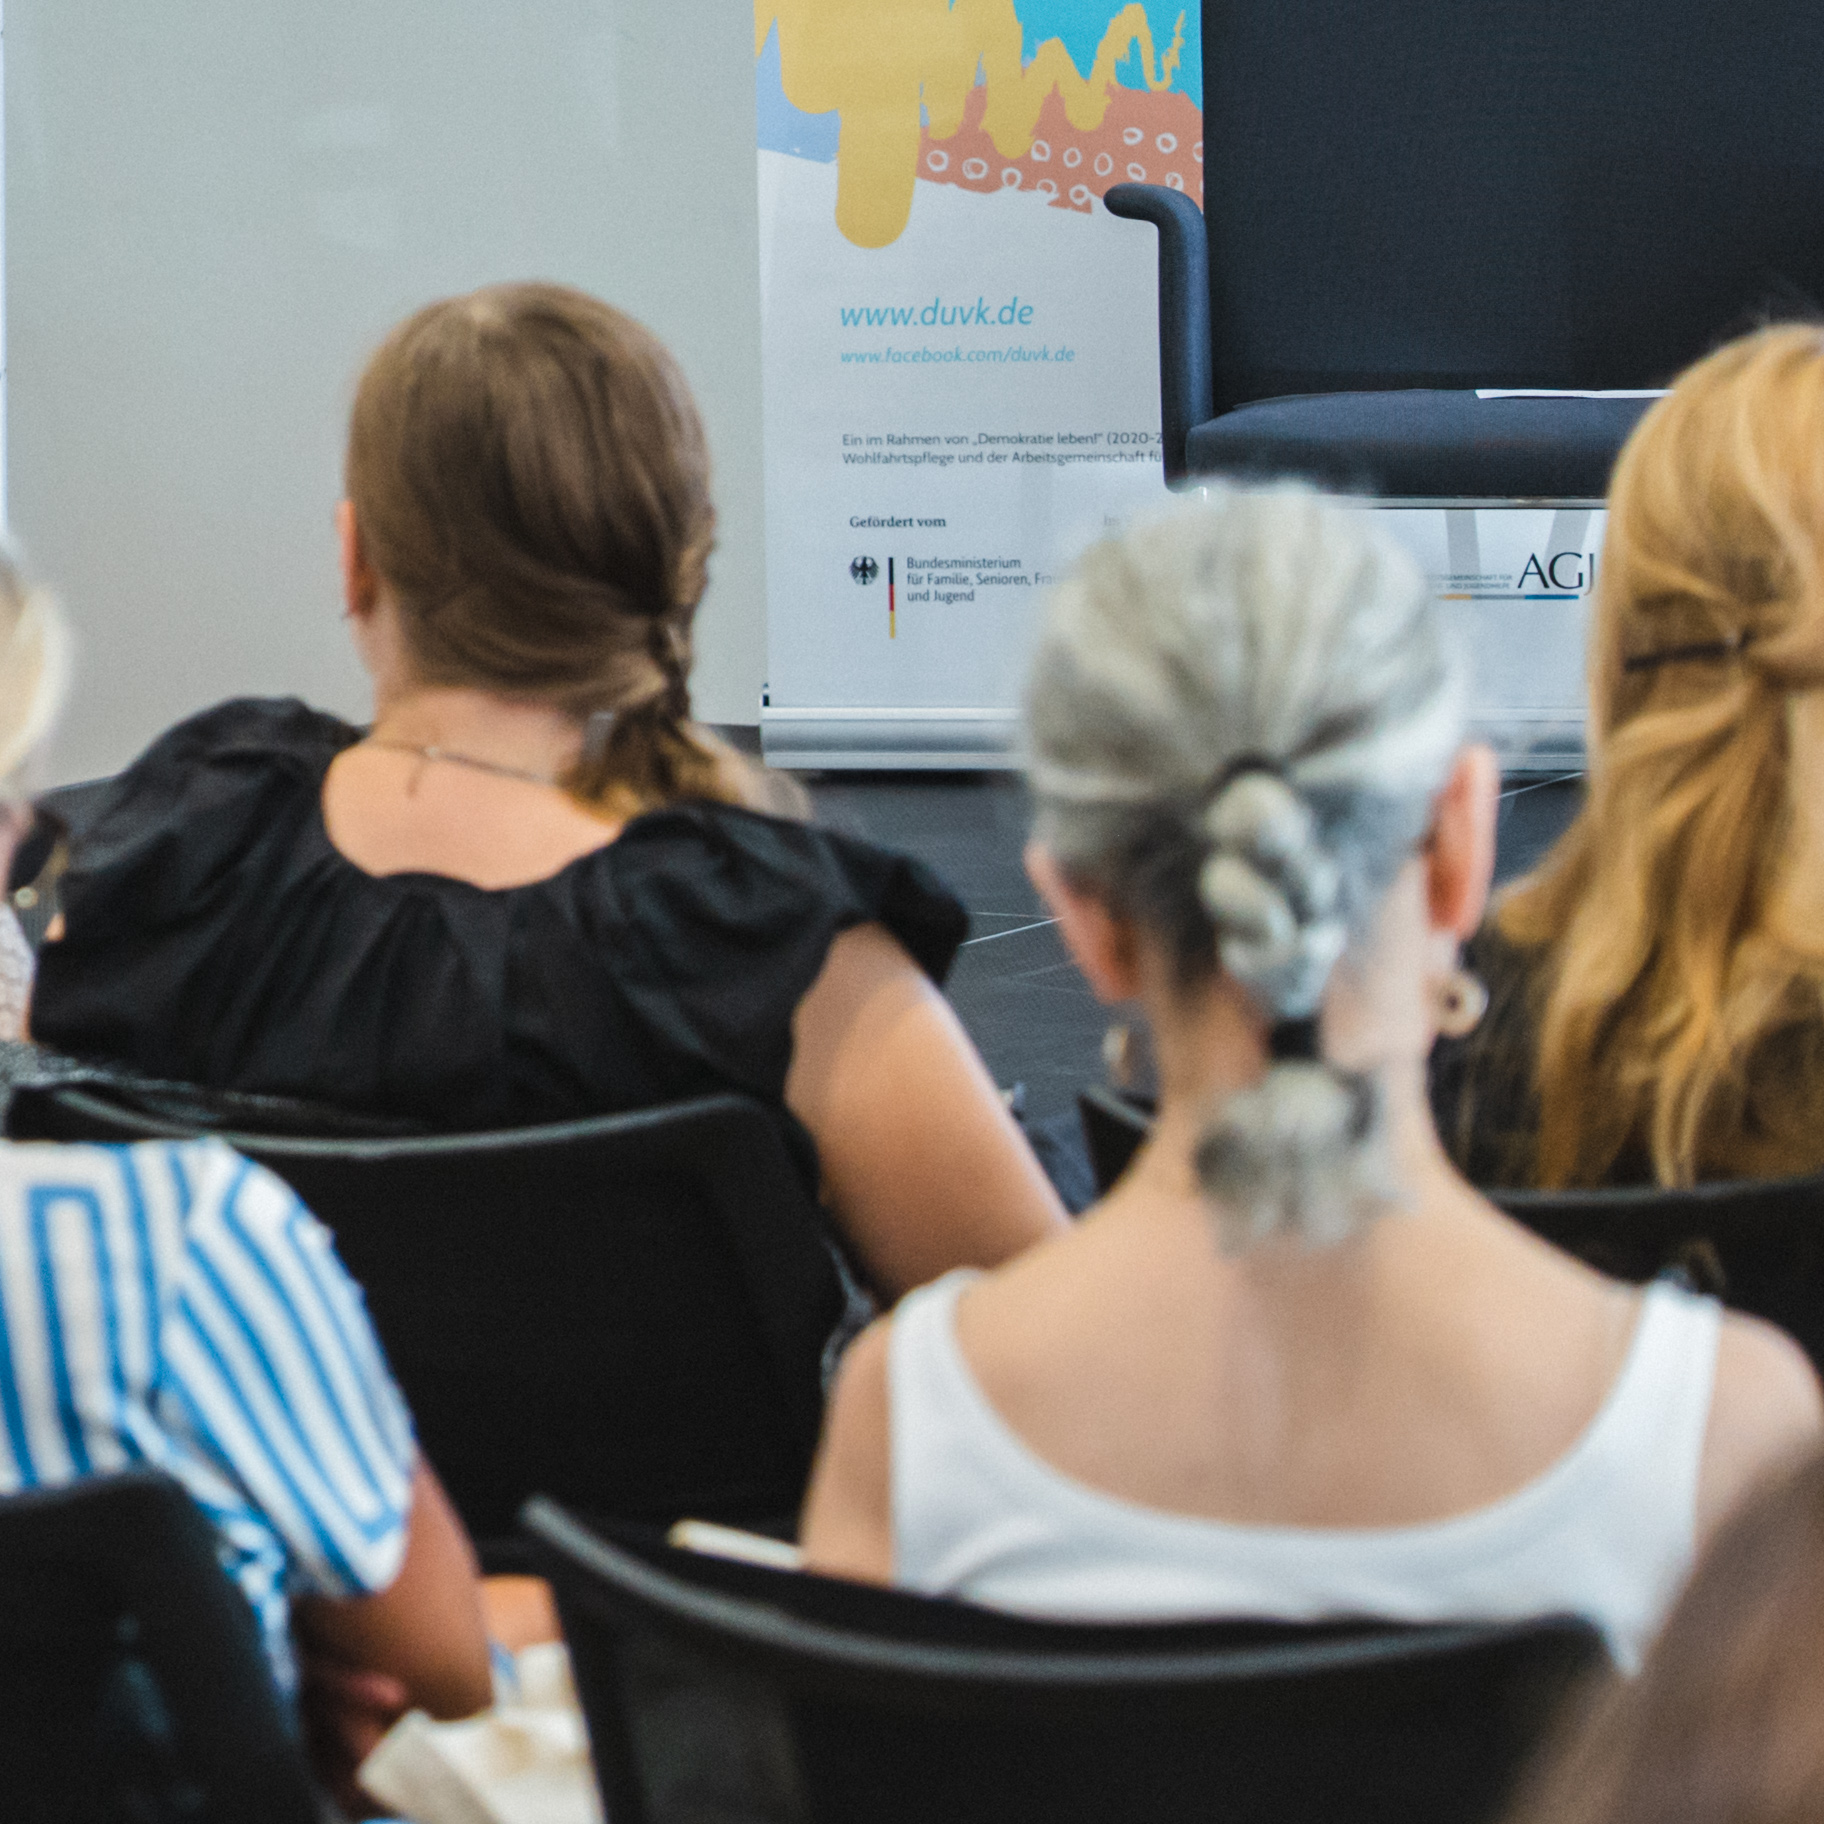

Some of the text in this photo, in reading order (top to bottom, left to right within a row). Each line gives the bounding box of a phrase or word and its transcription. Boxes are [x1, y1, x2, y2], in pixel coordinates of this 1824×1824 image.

[841, 296, 1034, 326] www.duvk.de
[841, 346, 1076, 363] www.facebook.com/duvk.de
[842, 434, 863, 446] Ein
[865, 434, 883, 446] im
[886, 434, 941, 445] Rahmen
[944, 436, 969, 445] von
[1106, 432, 1162, 446] (2020-2
[843, 451, 1162, 467] Wohlfahrtspflege und der Arbeitsgemeinschaft fü
[849, 516, 946, 528] Gefördert vom
[906, 557, 1021, 569] Bundesministerium
[907, 573, 923, 585] für
[927, 573, 972, 586] Familie,
[976, 573, 1032, 586] Senioren,
[1517, 551, 1595, 596] AGJ
[907, 590, 975, 604] und Jugend
